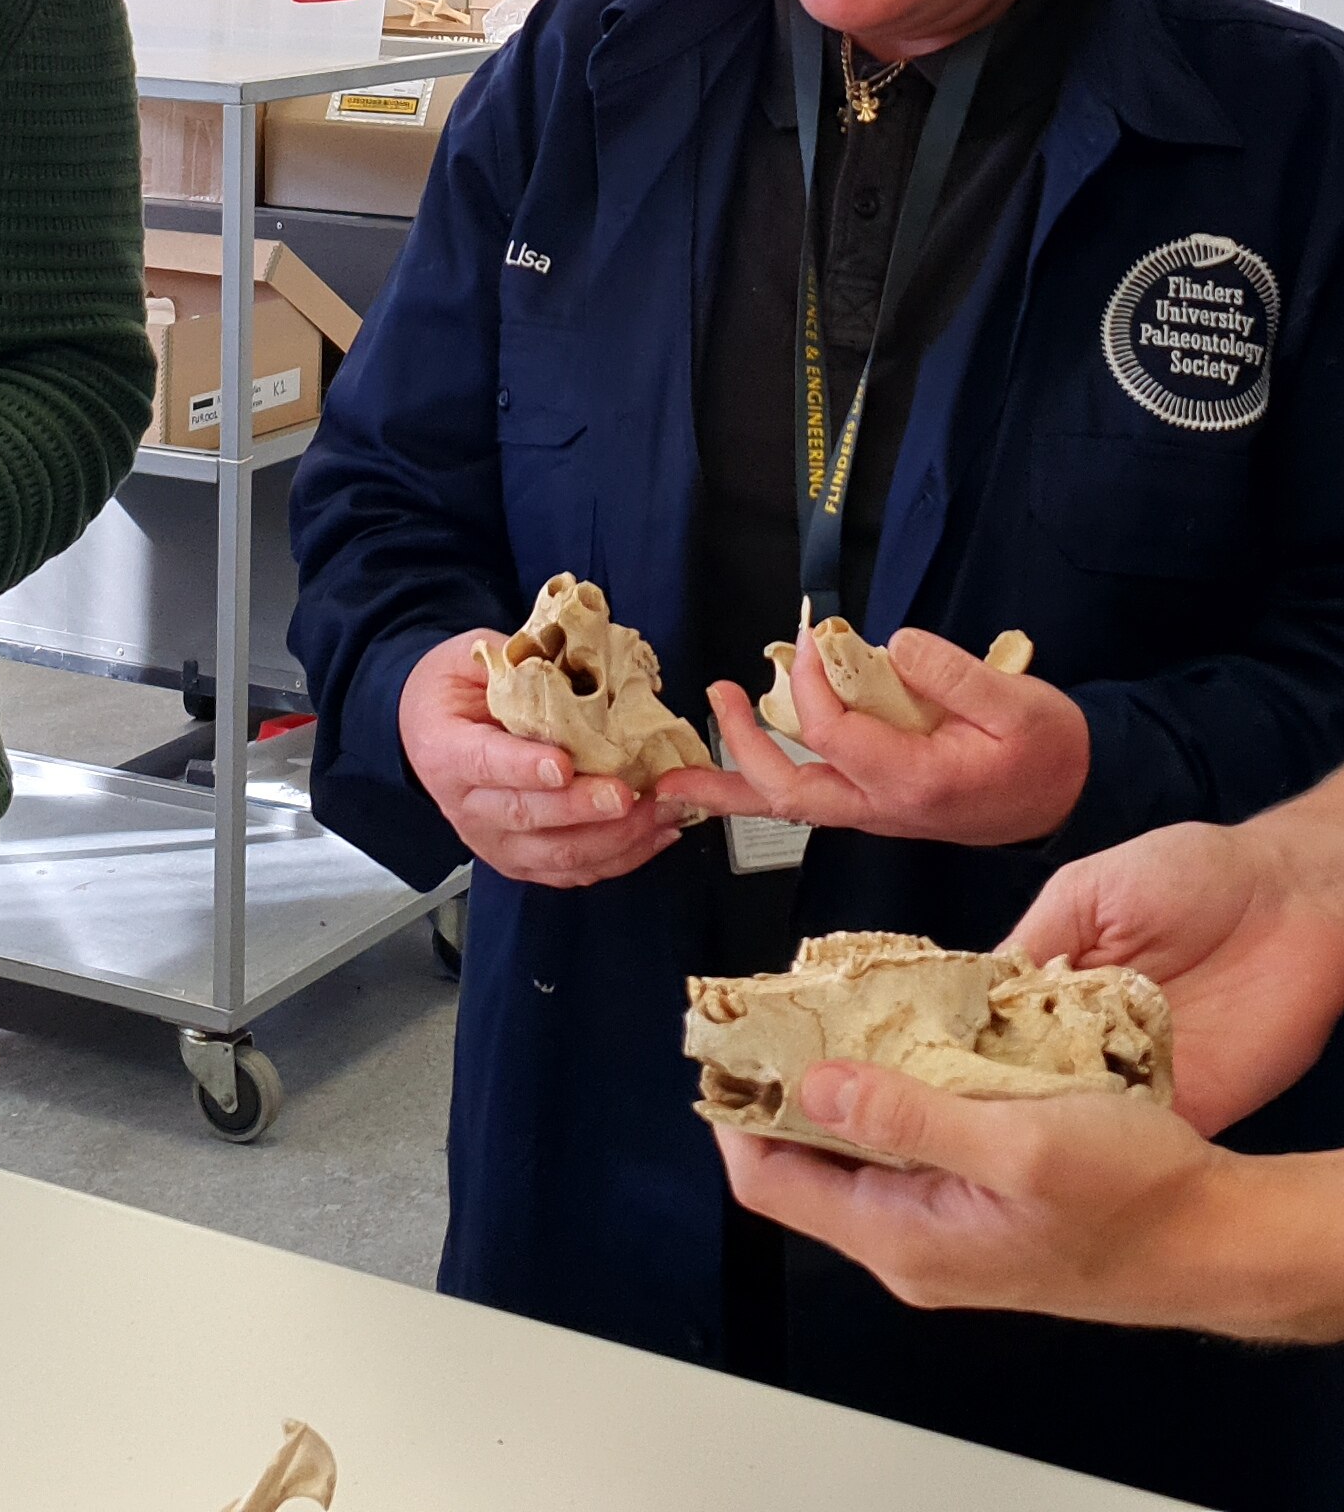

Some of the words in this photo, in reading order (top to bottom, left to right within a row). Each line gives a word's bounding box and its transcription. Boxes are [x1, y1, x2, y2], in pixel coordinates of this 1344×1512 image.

[505, 239, 552, 274] Lisa
[1167, 276, 1244, 306] Flinders
[1155, 299, 1255, 337] University
[805, 344, 821, 361] &
[1138, 322, 1265, 366] Palaeontology
[1170, 350, 1240, 386] Society
[273, 379, 287, 397] K1
